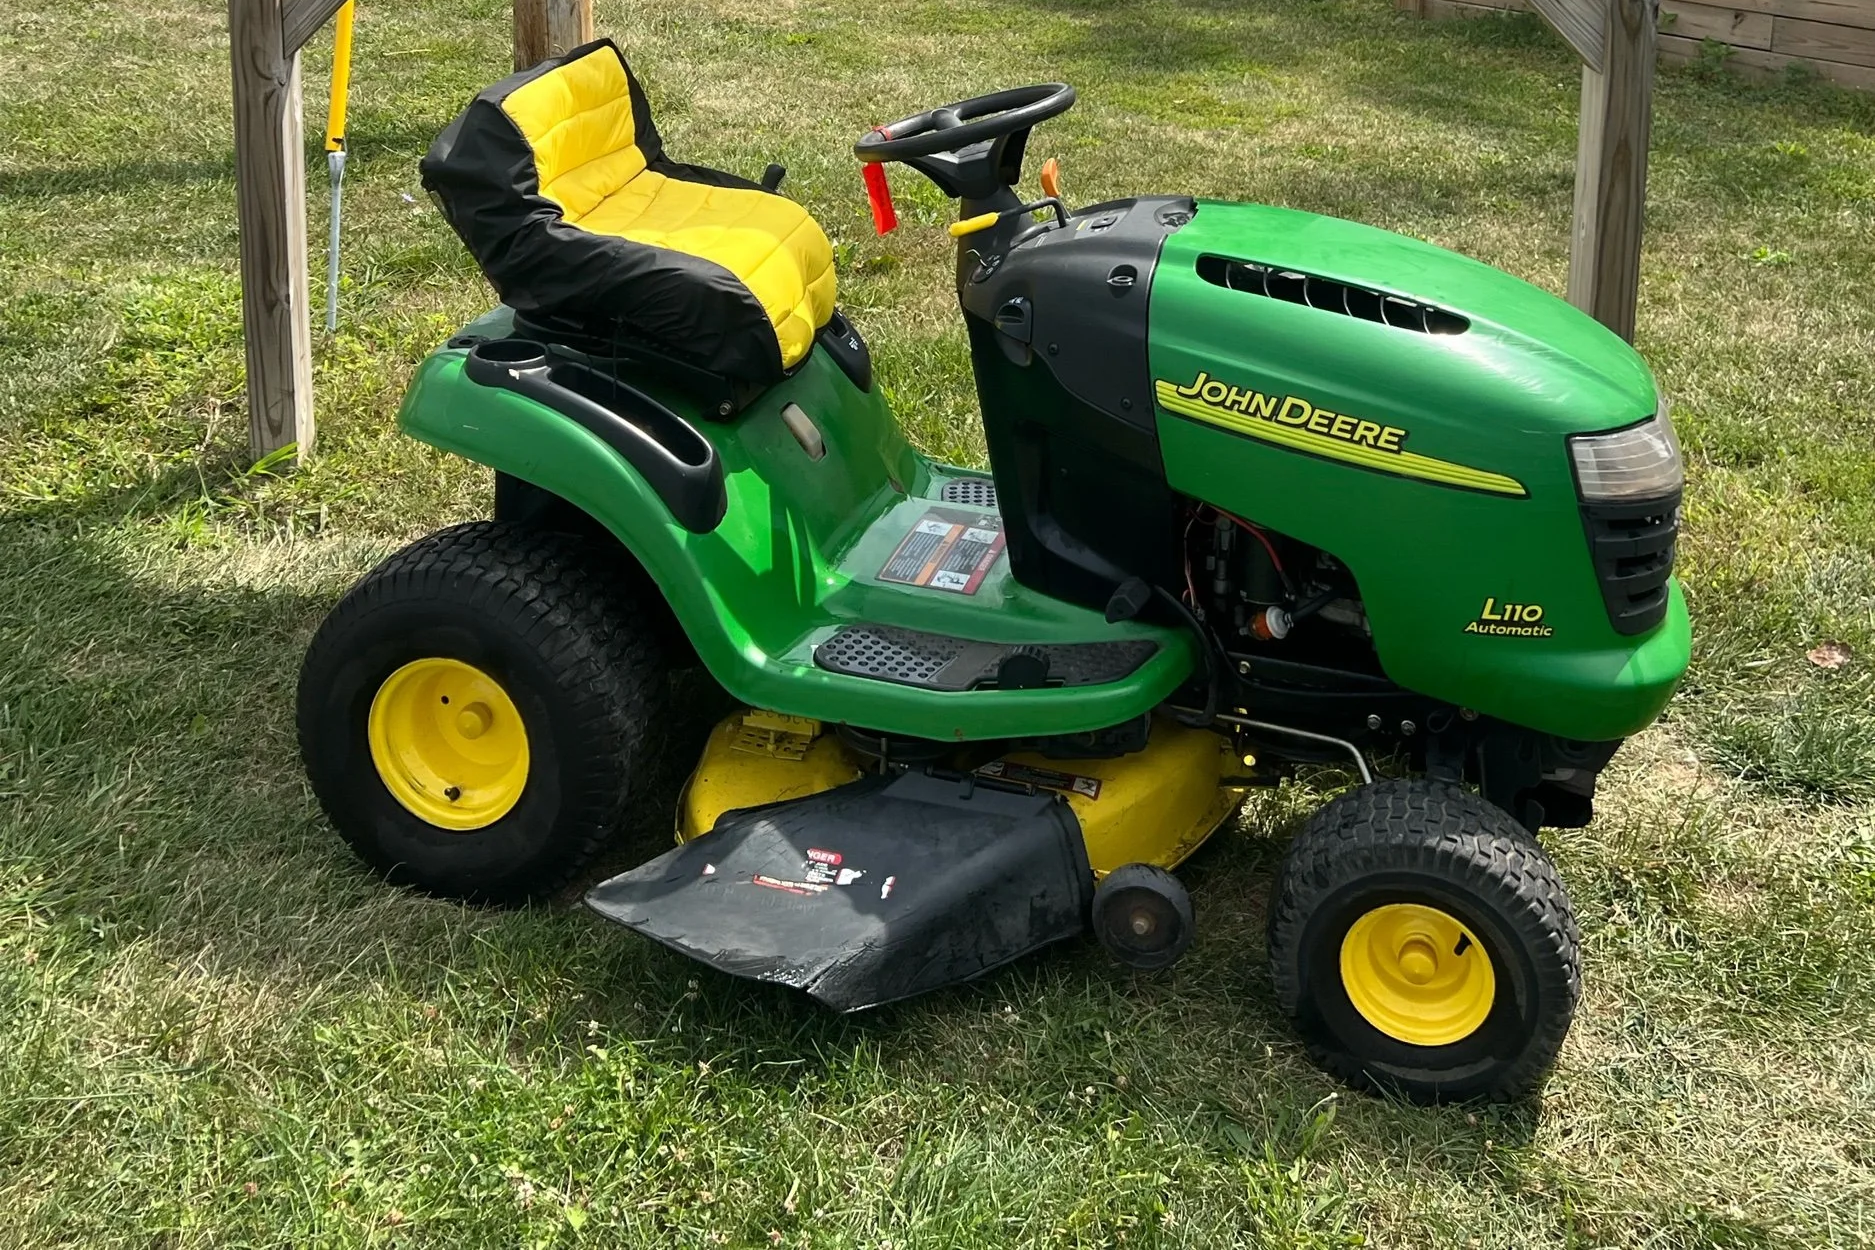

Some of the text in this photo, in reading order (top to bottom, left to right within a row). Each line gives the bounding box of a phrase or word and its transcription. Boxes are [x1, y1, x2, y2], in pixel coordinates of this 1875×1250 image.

[1177, 370, 1407, 452] JOHN DEERE
[1480, 597, 1543, 623] L110
[1464, 621, 1553, 637] Automatic
